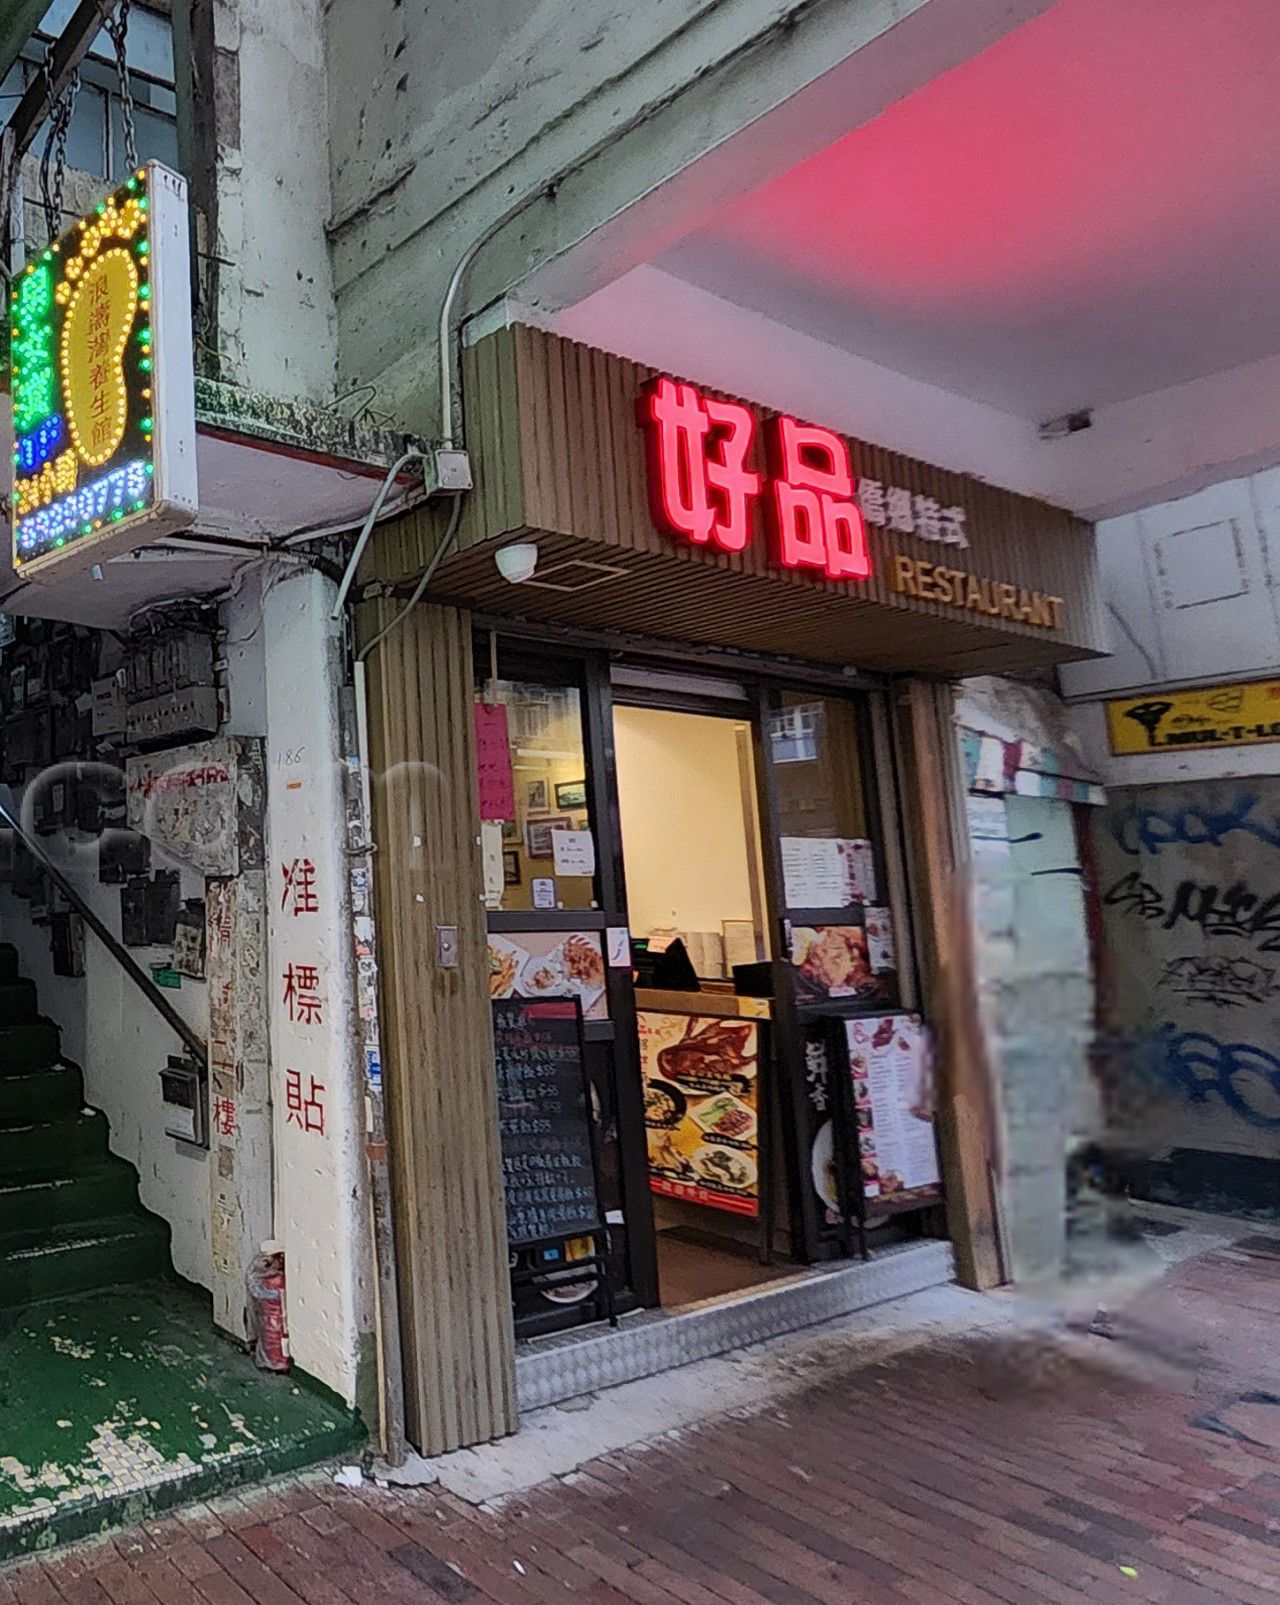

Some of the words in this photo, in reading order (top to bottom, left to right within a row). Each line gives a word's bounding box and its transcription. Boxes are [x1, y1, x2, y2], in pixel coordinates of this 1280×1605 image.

[648, 376, 872, 581] 好品
[894, 554, 1065, 630] RESTAURANT
[276, 746, 306, 772] 186
[280, 857, 327, 1138] 准標貼
